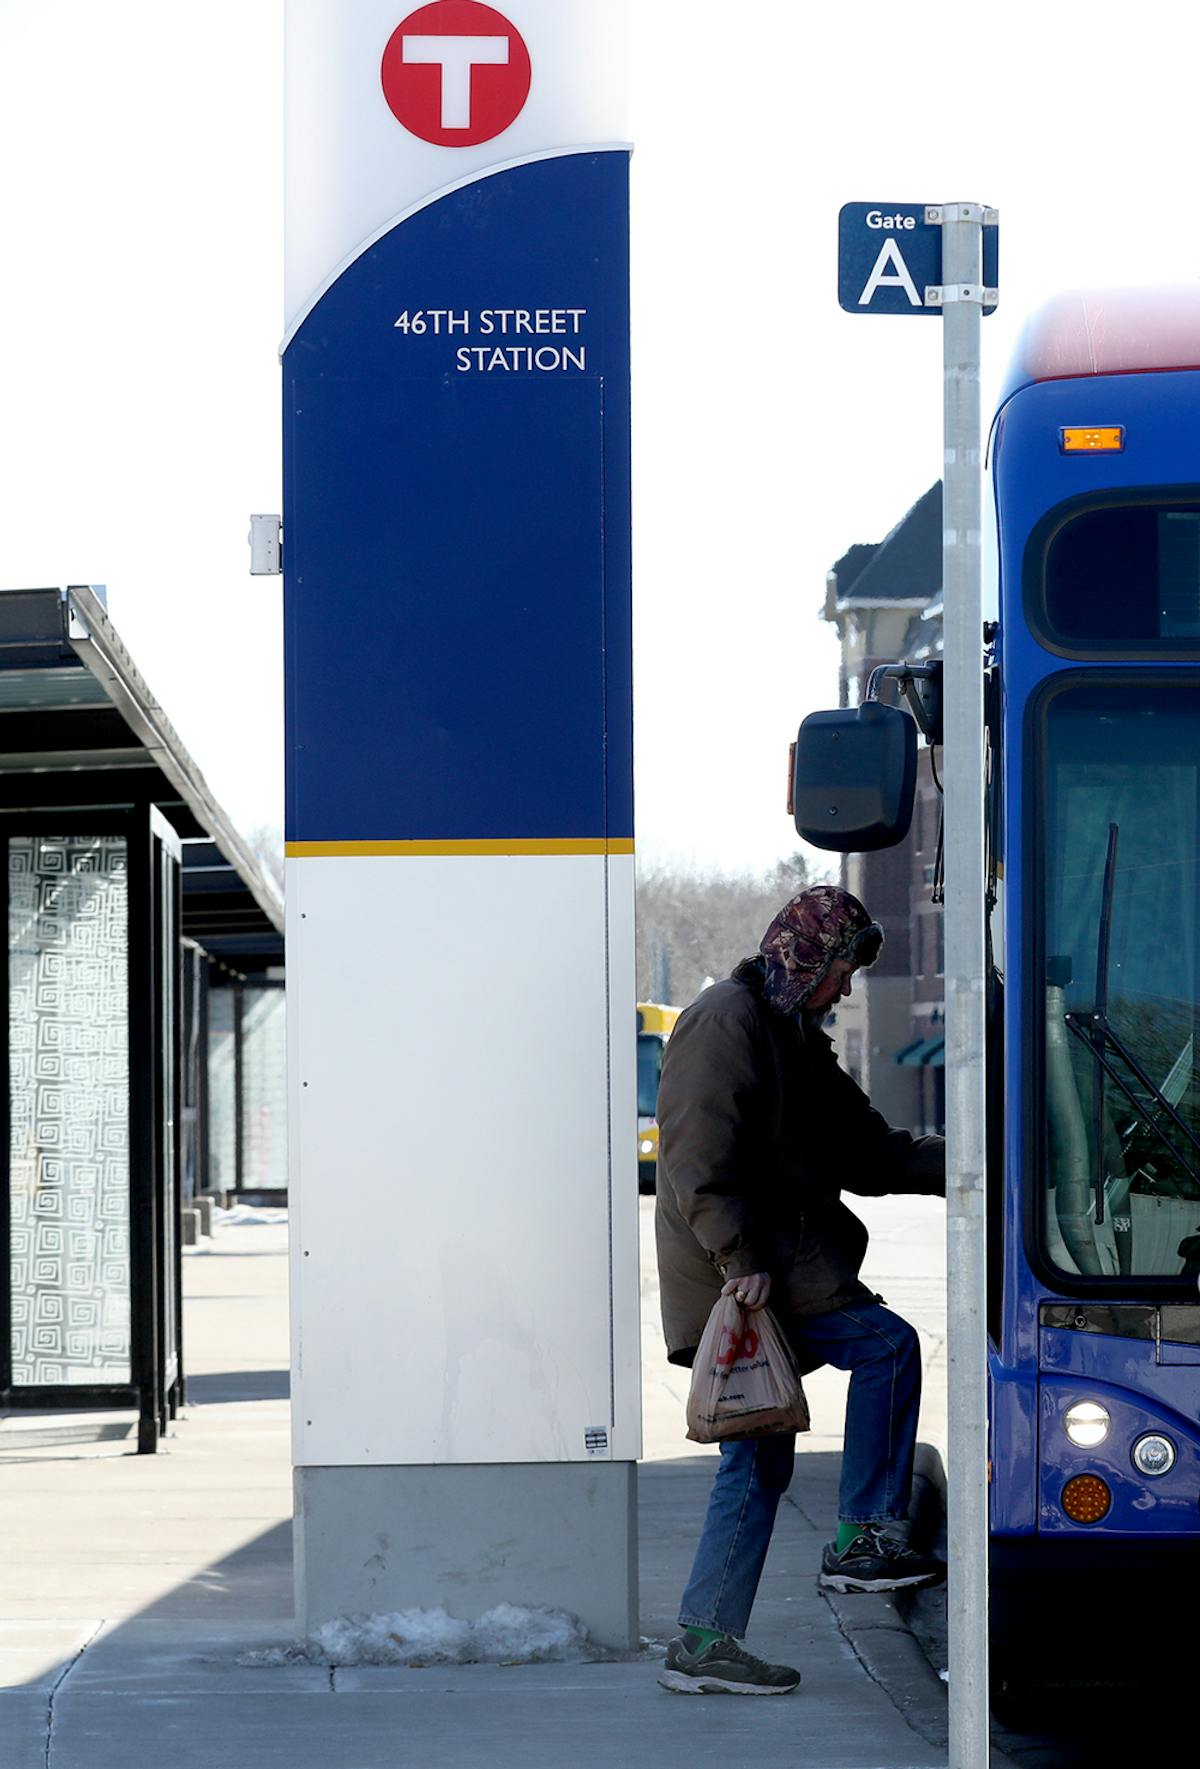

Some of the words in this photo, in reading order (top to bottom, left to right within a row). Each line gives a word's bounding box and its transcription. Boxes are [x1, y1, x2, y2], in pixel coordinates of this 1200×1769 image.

[402, 35, 509, 129] T
[865, 210, 917, 230] Gate
[858, 237, 923, 307] A
[393, 310, 470, 335] 46TH
[479, 309, 587, 335] STREET
[456, 346, 586, 372] STATION
